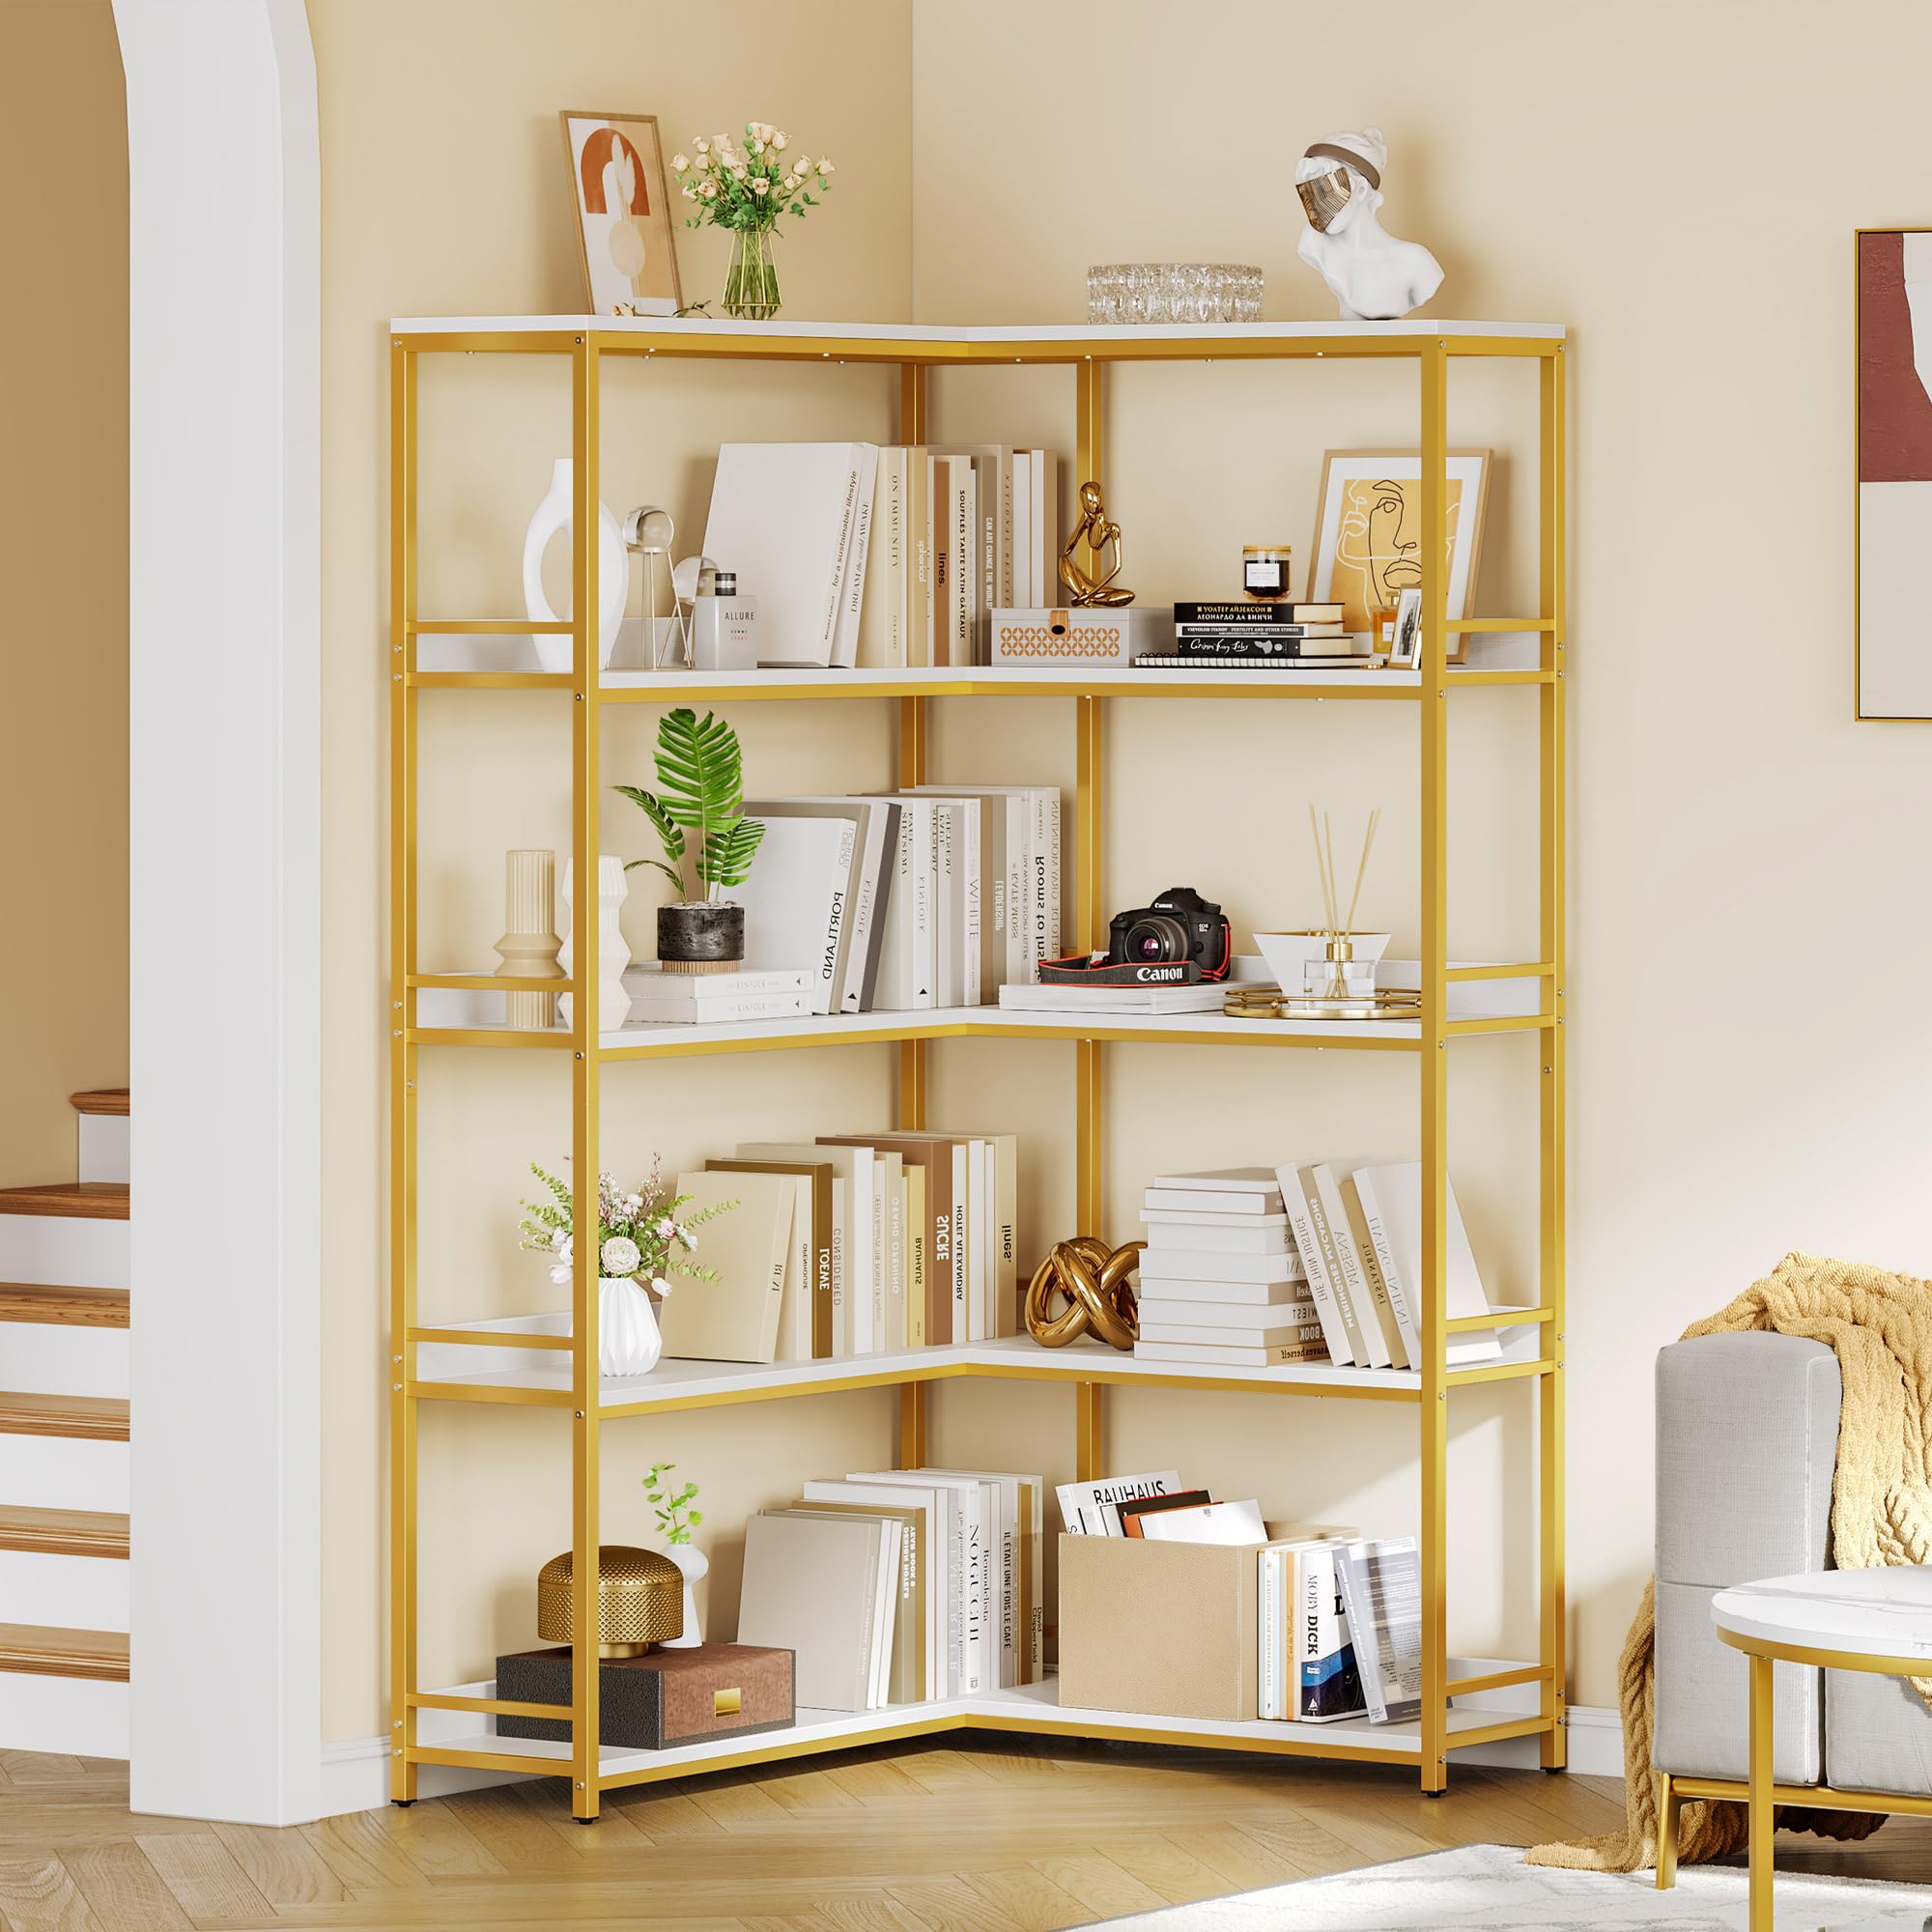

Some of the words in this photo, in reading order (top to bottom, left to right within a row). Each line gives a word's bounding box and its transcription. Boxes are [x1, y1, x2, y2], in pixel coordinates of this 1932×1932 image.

[892, 475, 898, 492] ON
[838, 509, 851, 563] sustainable
[847, 470, 858, 509] lifestyle
[917, 540, 926, 582] spherical
[851, 573, 862, 612] DREAM
[724, 611, 754, 620] ALLURE
[970, 879, 979, 941] WHITE
[1137, 967, 1183, 981] Canon
[1093, 1481, 1166, 1504] BAUHAUS
[1004, 1531, 1011, 1540] IL
[970, 1524, 979, 1641] NOGUCHI
[1307, 1574, 1318, 1612] MOBY
[1004, 1612, 1011, 1624] LE
[1308, 1615, 1318, 1655] DICK
